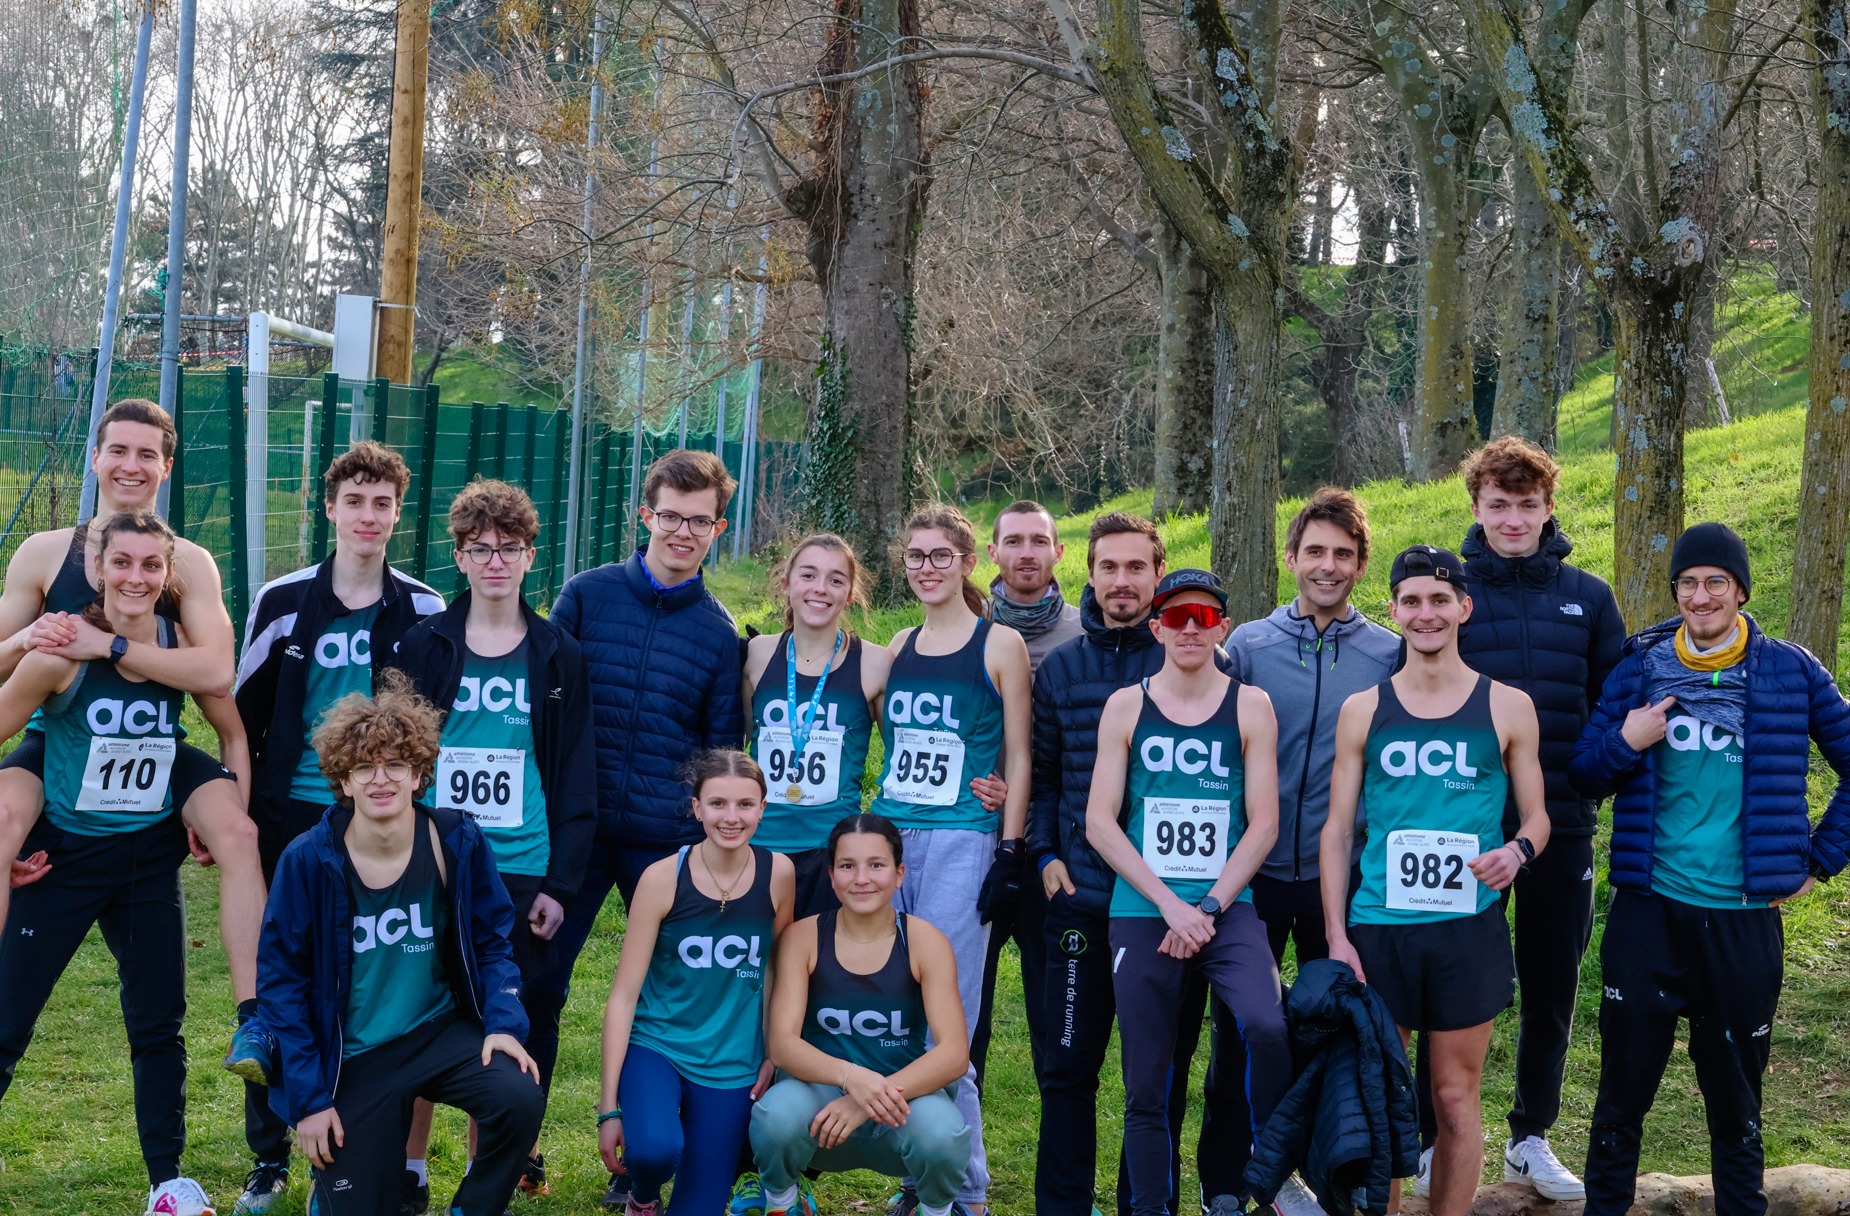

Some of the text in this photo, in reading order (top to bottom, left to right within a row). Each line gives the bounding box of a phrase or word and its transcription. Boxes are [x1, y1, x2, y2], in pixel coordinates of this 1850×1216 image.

[1170, 573, 1210, 589] HOKA
[314, 630, 372, 668] ac
[99, 758, 156, 790] 110
[768, 748, 826, 786] 956
[896, 750, 950, 786] 955
[1724, 752, 1743, 762] Tas
[450, 769, 510, 805] 966
[1198, 778, 1229, 790] Tassin
[1442, 778, 1475, 790] Tassin
[1156, 820, 1216, 857] 983
[1400, 852, 1464, 890] 982
[401, 940, 434, 953] Tassin
[1061, 958, 1078, 1047] terre de running
